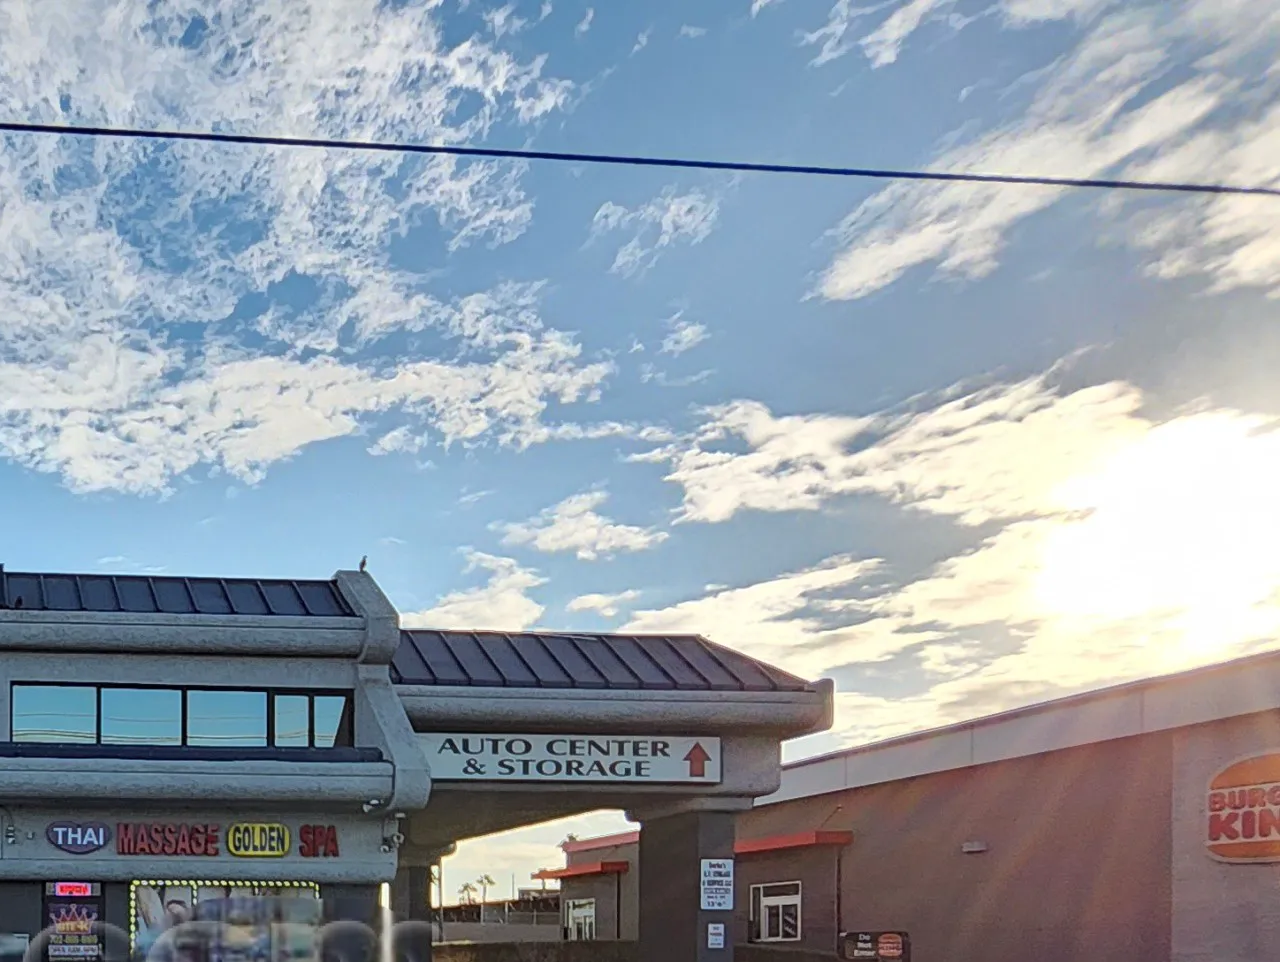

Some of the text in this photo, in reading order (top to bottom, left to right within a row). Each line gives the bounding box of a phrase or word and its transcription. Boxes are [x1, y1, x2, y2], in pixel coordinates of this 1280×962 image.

[437, 738, 671, 758] AUTO CENTER
[462, 758, 651, 778] & STORAGE
[53, 822, 340, 858] THAI MASSAGE GOLDEN SPA
